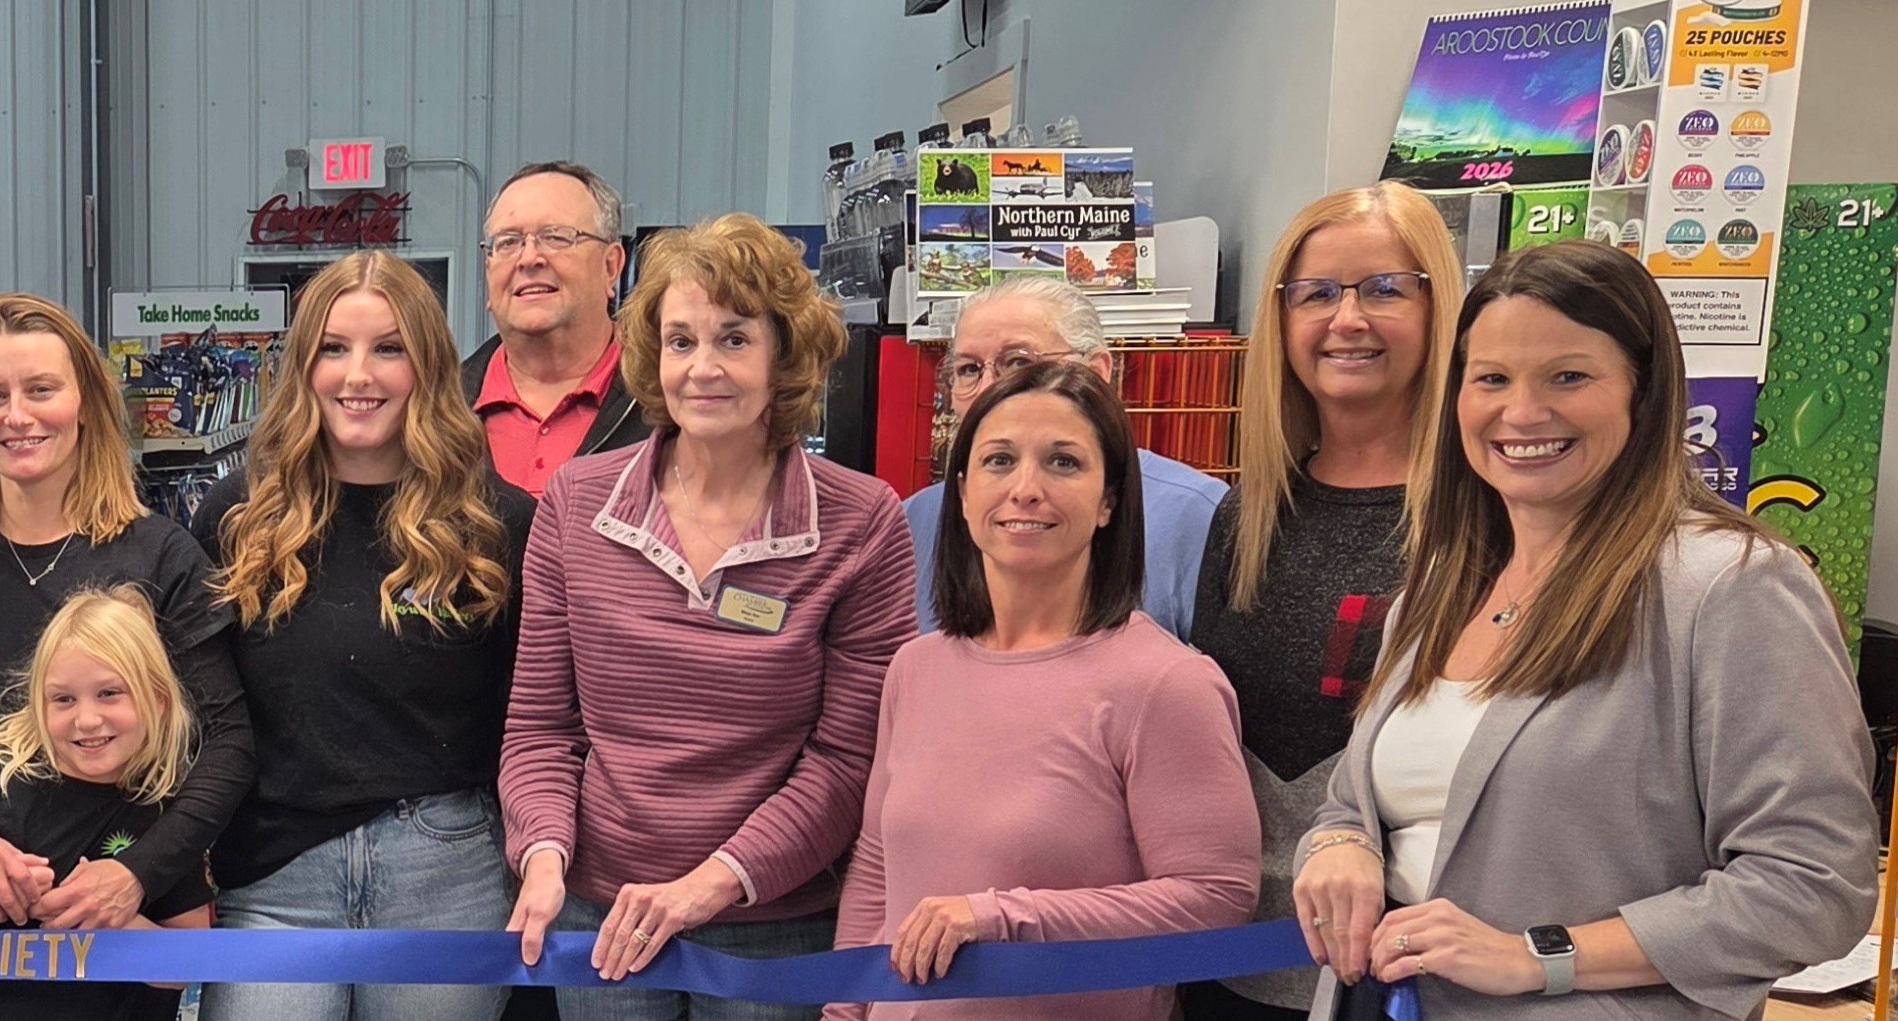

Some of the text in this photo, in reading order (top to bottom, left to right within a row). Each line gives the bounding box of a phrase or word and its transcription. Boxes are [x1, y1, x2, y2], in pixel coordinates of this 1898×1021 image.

[1432, 21, 1555, 56] AROOSTOOK
[1685, 30, 1787, 45] 25 POUCHES
[323, 143, 373, 183] EXIT
[1460, 160, 1514, 181] 2026
[997, 206, 1131, 226] Northern Maine
[1527, 204, 1575, 233] 21+
[1837, 198, 1885, 227] 21+
[1010, 226, 1033, 238] with
[1034, 225, 1058, 238] Paul
[1059, 225, 1082, 240] Cyr
[1670, 290, 1741, 299] WARNING: This
[137, 301, 260, 323] Take Home Snacks
[1703, 302, 1742, 310] contains
[1699, 312, 1737, 321] Nicotine
[1738, 312, 1747, 320] is
